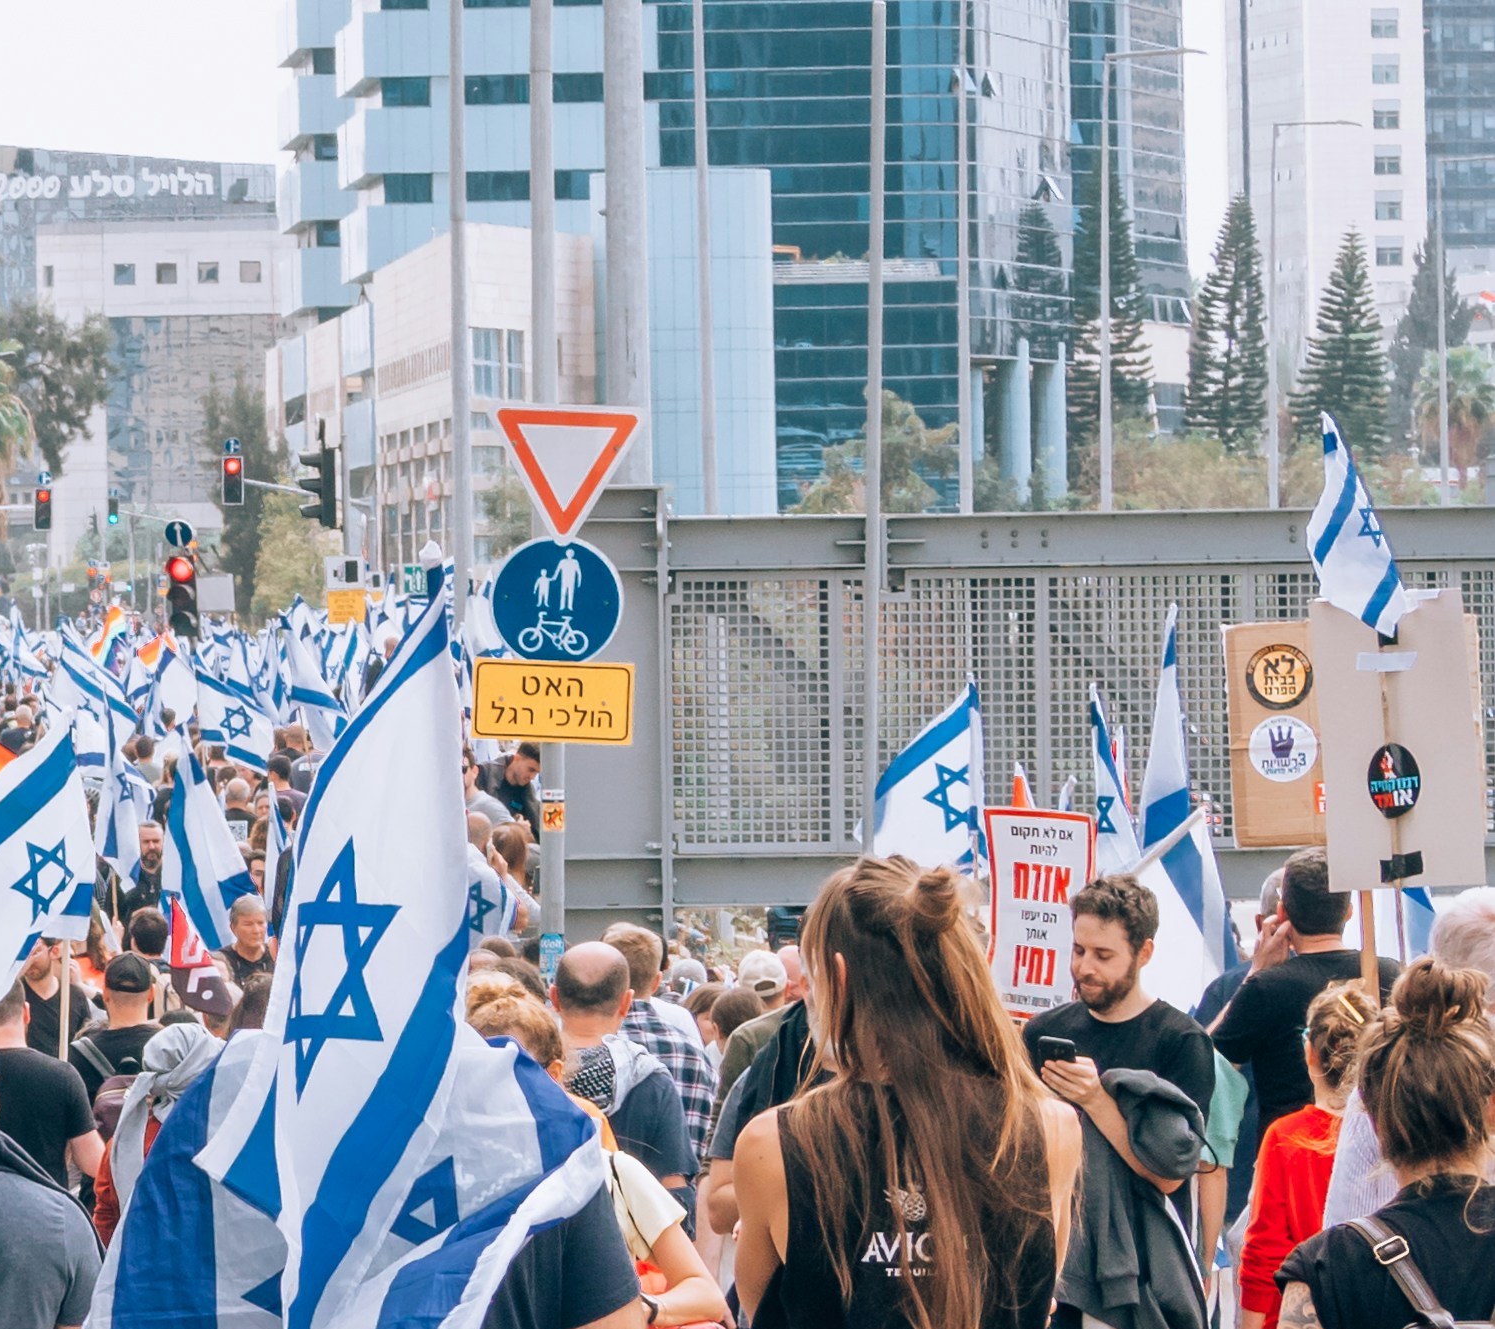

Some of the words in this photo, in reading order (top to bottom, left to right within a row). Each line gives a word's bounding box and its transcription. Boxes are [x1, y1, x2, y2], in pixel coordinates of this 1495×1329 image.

[68, 169, 136, 198] סלע
[1263, 654, 1295, 675] לא
[522, 675, 584, 698] האט
[1264, 675, 1296, 686] בבית
[1264, 686, 1297, 695] ספרנו
[491, 700, 534, 725] רגל
[549, 704, 613, 729] הולכי
[1297, 752, 1307, 766] 3
[1010, 826, 1040, 840] תקום
[1043, 826, 1057, 839] לא
[1058, 830, 1074, 841] אם
[1030, 844, 1058, 857] להיות
[1013, 861, 1072, 905] אזרח
[1042, 912, 1058, 924] הם
[1025, 927, 1048, 942] אותך
[1012, 944, 1057, 988] נתין
